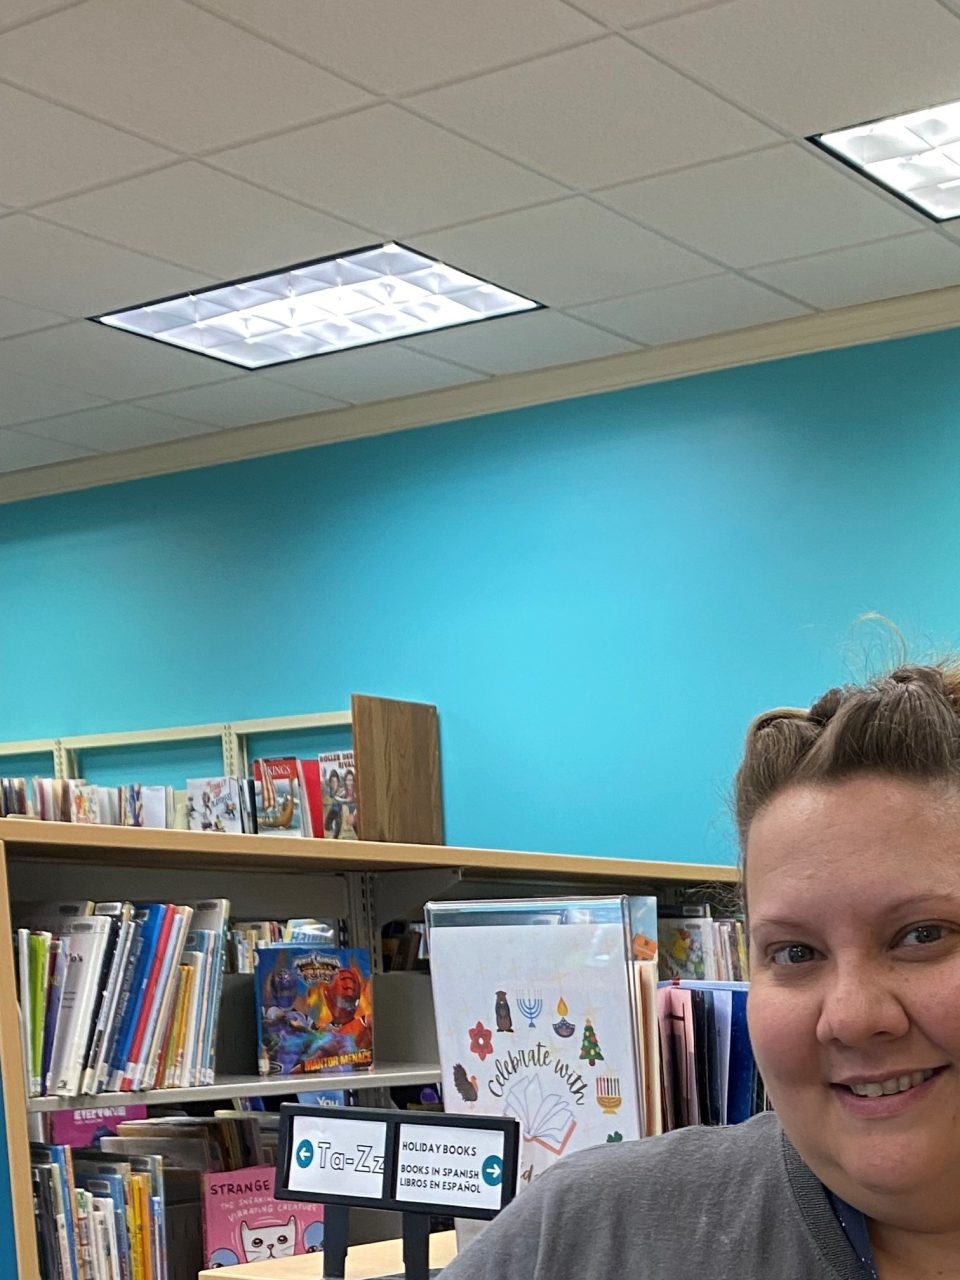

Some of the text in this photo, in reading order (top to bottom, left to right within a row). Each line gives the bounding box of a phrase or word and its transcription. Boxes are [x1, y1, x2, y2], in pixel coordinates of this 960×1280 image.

[267, 764, 291, 776] KINGS
[486, 1041, 589, 1106] Celebrate with
[316, 1095, 339, 1107] You
[402, 1141, 478, 1157] HOLIDAY BOOKS
[317, 1140, 386, 1176] Ta-Zz
[400, 1164, 480, 1180] BOOKS IN SPANISH
[210, 1179, 271, 1196] STRANGE
[399, 1177, 482, 1195] LIBROS EN ESPAÑOL
[228, 1203, 318, 1222] VIBRATING CREATURE
